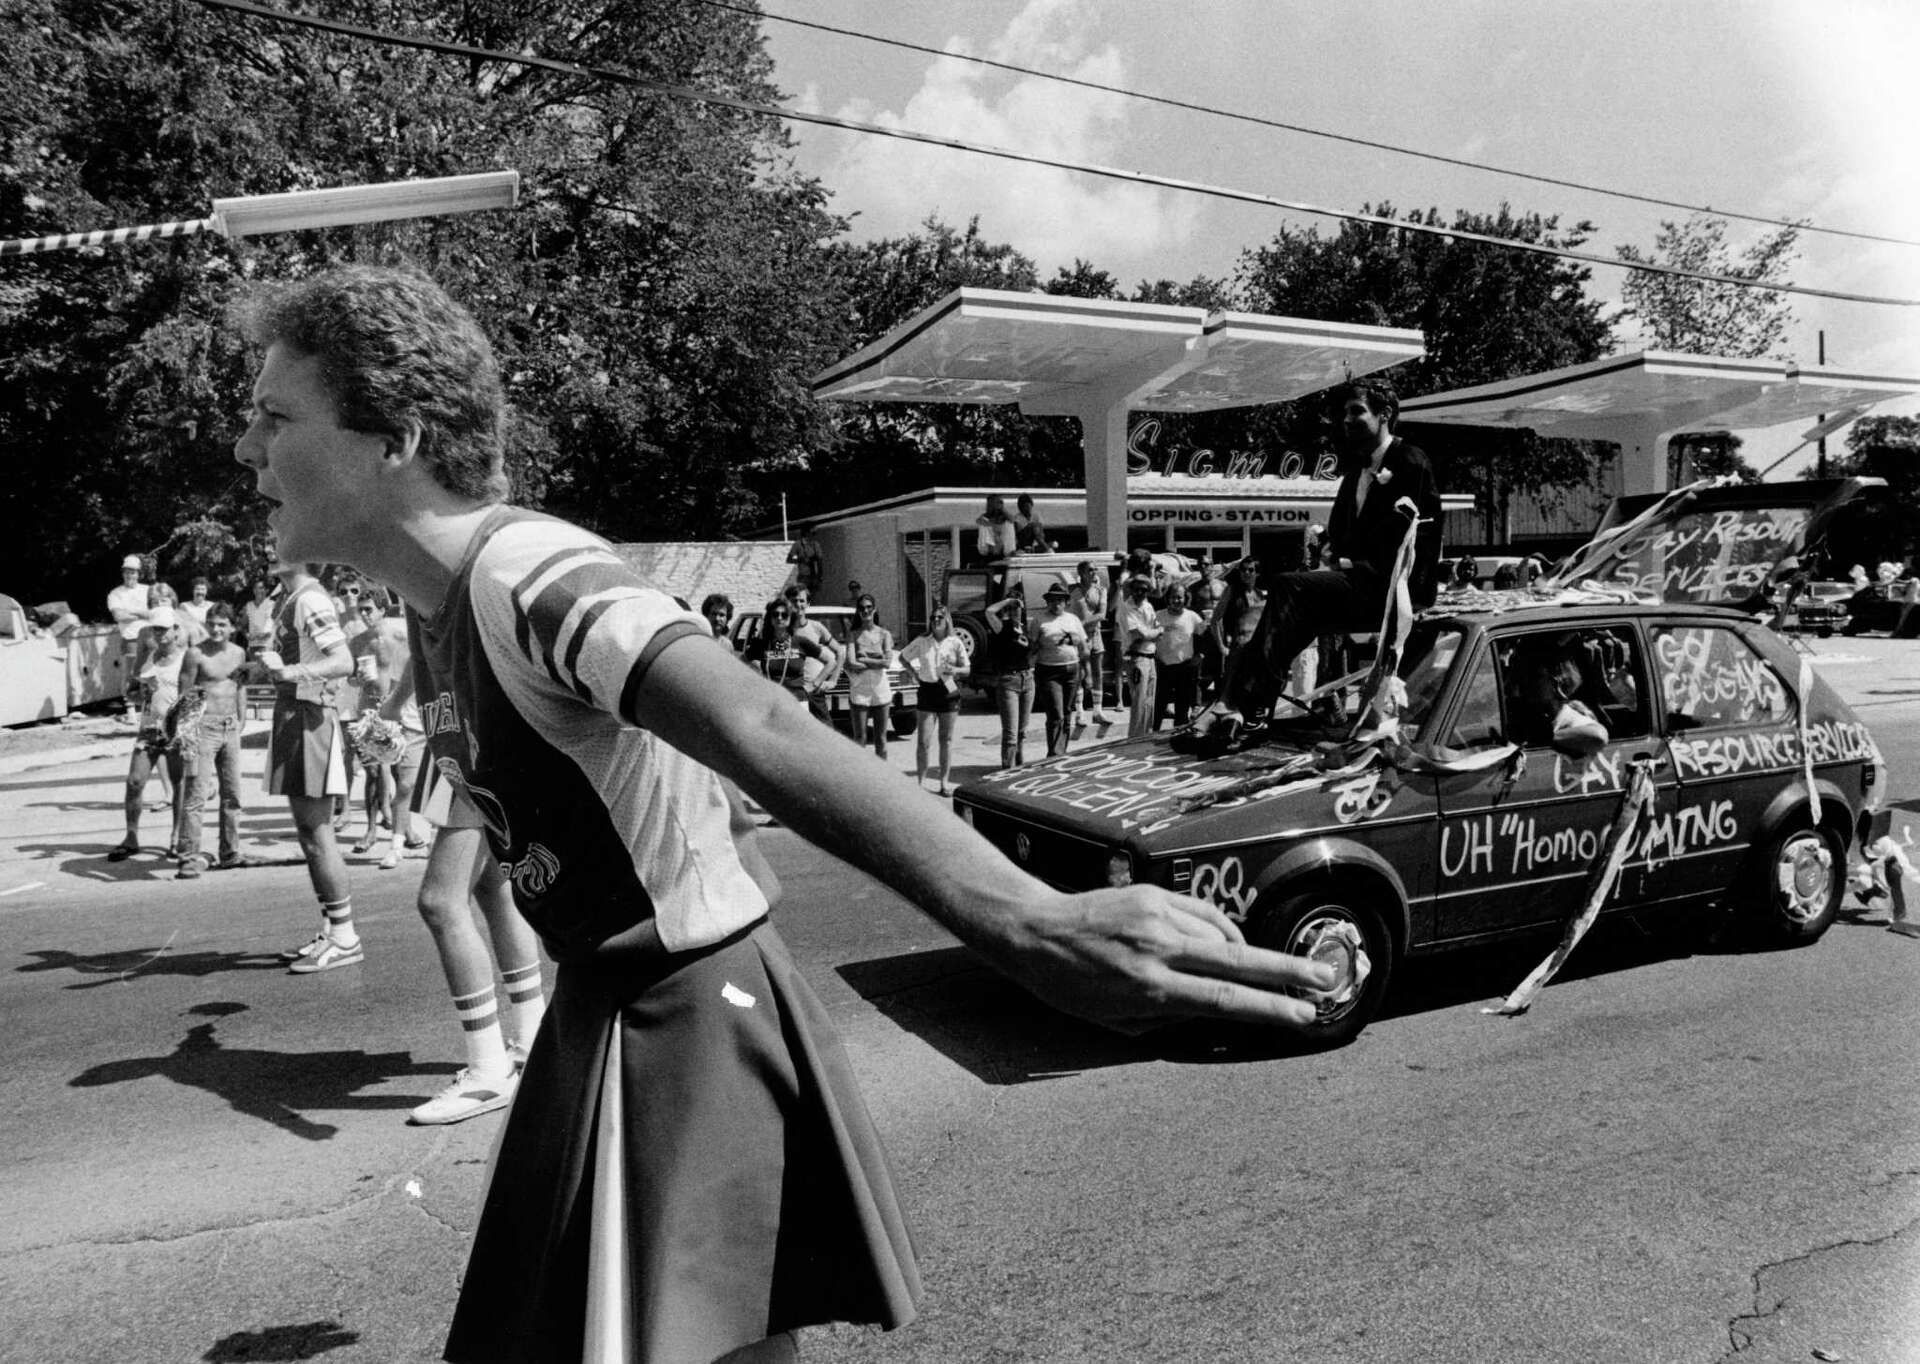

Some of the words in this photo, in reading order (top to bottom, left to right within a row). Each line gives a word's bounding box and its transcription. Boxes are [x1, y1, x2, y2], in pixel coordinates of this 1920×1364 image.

[1127, 509, 1214, 522] OPPING
[1225, 510, 1311, 522] STATION
[1554, 749, 1622, 794] GAY
[1668, 733, 1800, 777] RESOURCE
[1007, 772, 1172, 818] QUEEN
[1440, 814, 1494, 877] UH
